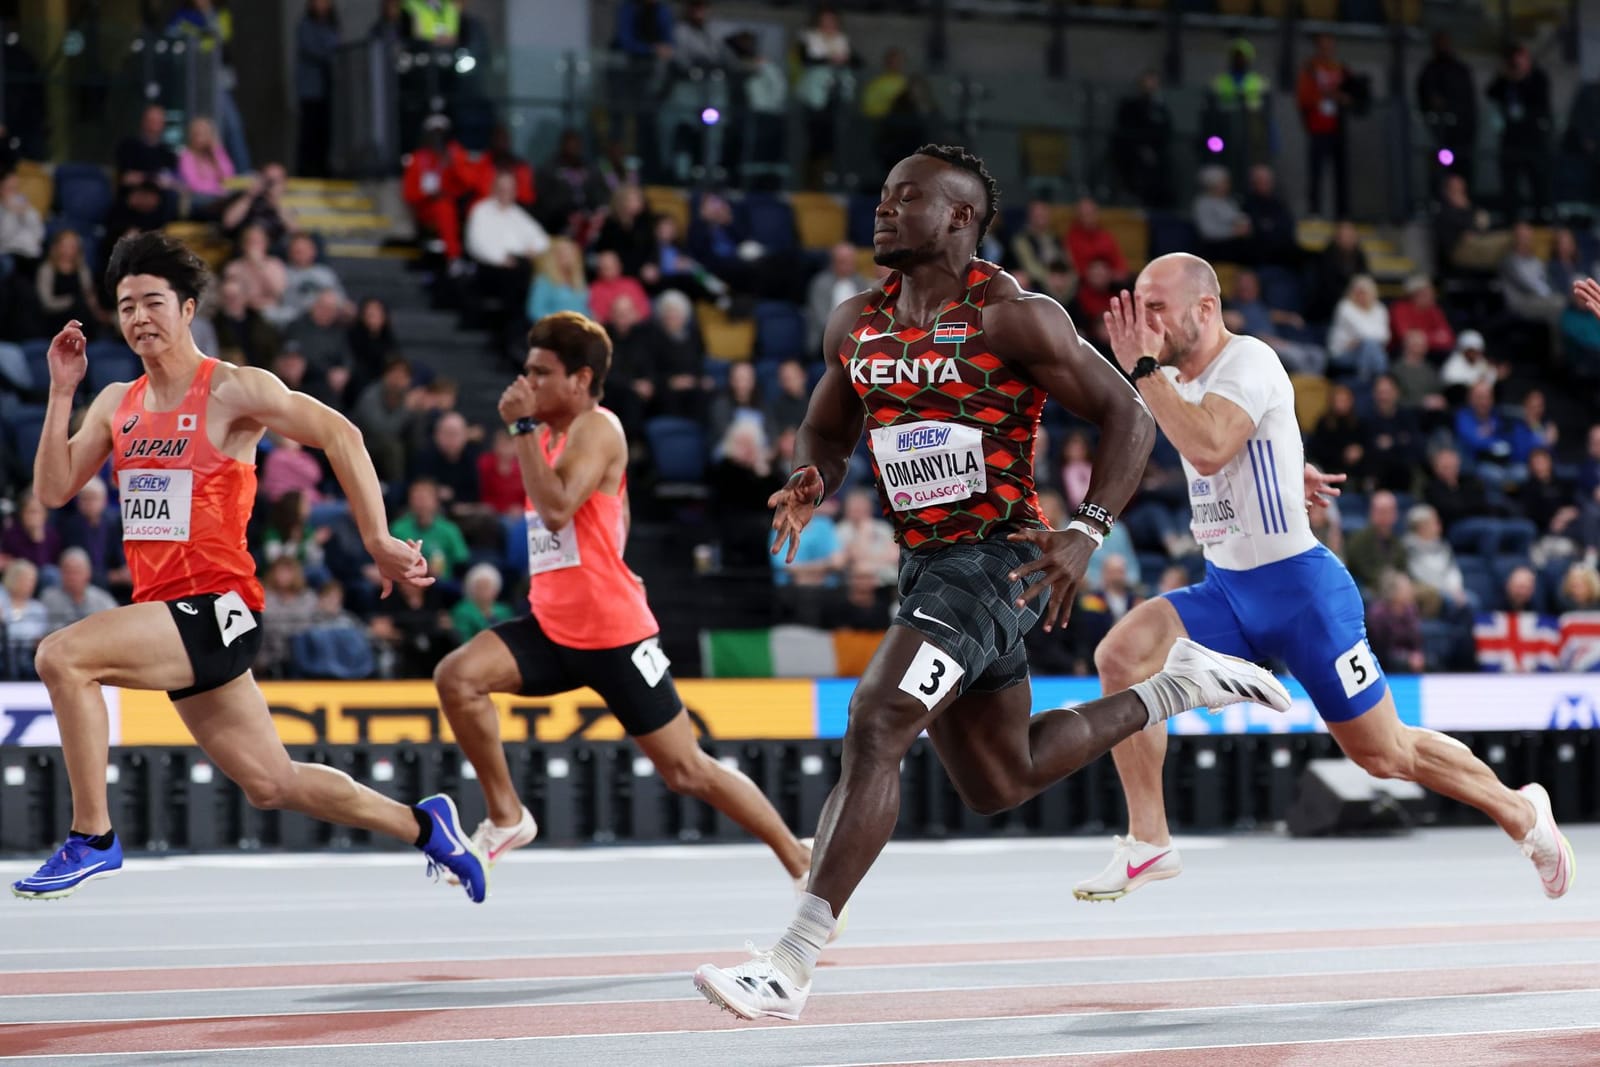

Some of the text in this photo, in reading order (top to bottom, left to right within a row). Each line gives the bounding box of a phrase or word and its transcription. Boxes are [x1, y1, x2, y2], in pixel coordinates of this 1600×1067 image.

[850, 357, 963, 385] KENYA
[124, 438, 188, 458] JAPAN
[124, 498, 171, 520] TADA
[125, 526, 186, 536] GLASGOW 24
[919, 658, 946, 696] 3
[1349, 654, 1367, 685] 5
